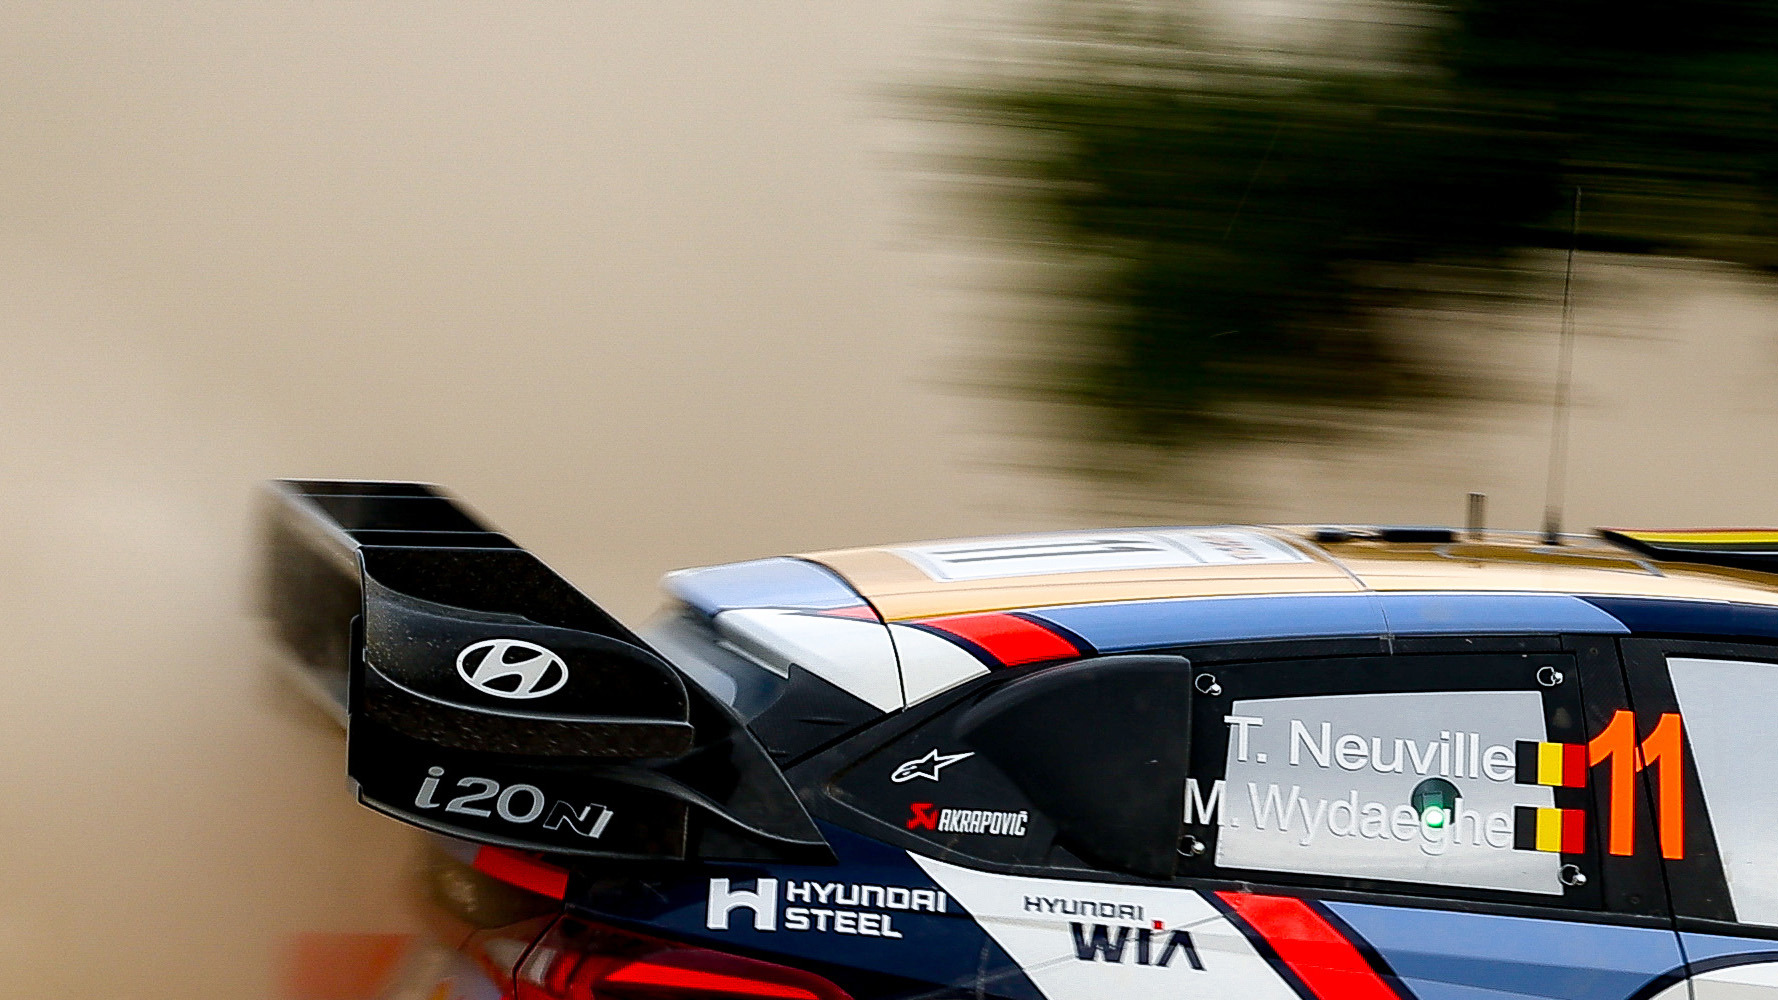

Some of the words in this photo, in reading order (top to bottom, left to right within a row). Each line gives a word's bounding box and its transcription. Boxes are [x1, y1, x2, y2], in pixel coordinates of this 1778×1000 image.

[1224, 715, 1267, 763] T.
[1289, 719, 1516, 780] Neuville
[1588, 709, 1685, 860] 11
[938, 808, 1028, 836] AKRAPOVIČ
[1183, 778, 1238, 828] M.
[1248, 780, 1514, 855] Wydaeghe
[786, 880, 946, 913] HYUNDAI
[1024, 895, 1145, 921] HYUNDAI
[785, 907, 903, 938] STEEL
[1069, 919, 1207, 972] WIA
